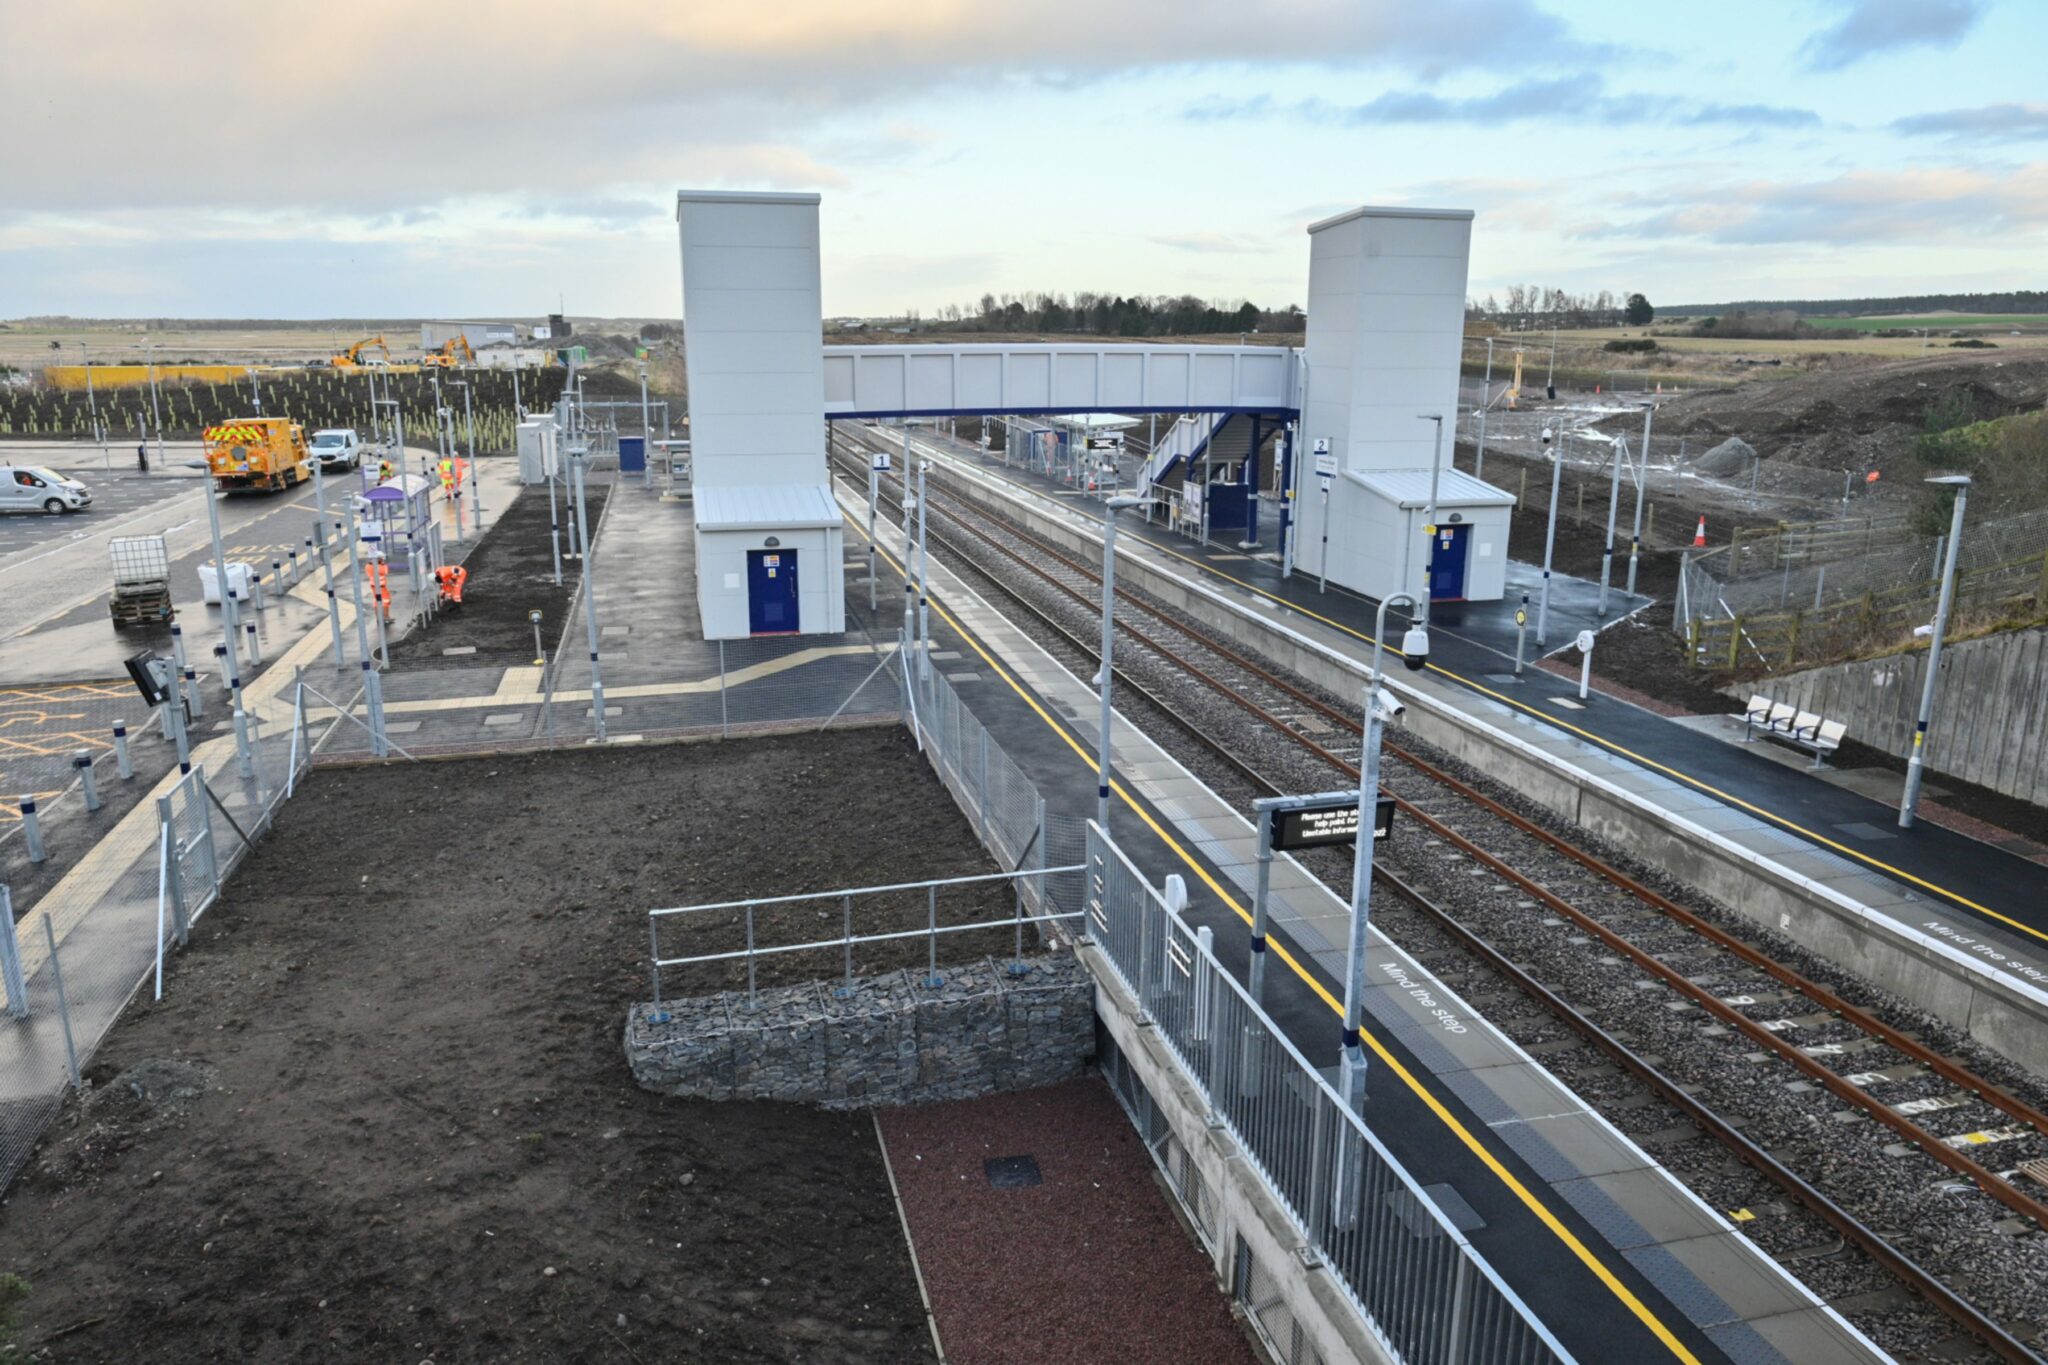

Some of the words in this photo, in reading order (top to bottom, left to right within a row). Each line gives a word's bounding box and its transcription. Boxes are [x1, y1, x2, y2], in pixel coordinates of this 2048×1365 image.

[1318, 440, 1325, 451] 2
[878, 455, 885, 466] 1
[1922, 922, 1976, 944] Mind
[1972, 944, 2006, 961] the
[1379, 963, 1420, 988] Mind
[1410, 989, 1437, 1007] the
[1431, 1009, 1467, 1034] step
